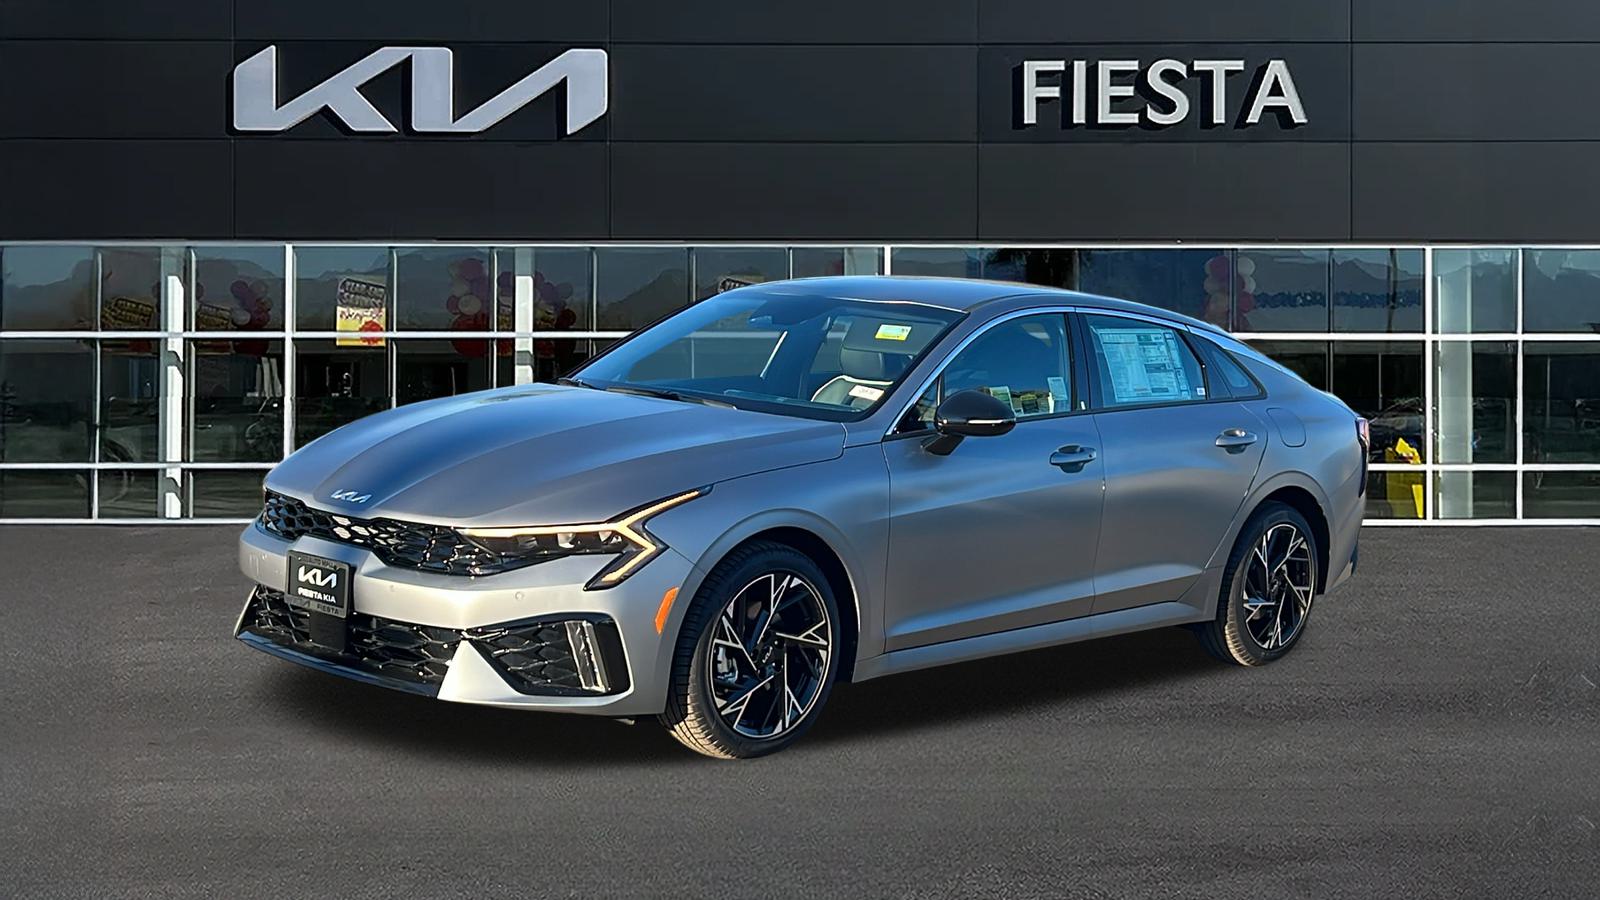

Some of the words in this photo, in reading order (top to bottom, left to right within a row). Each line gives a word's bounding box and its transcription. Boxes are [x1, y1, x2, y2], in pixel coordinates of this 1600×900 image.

[233, 44, 608, 135] KIA
[1023, 59, 1308, 125] FIESTA
[331, 488, 372, 504] KIA
[298, 565, 337, 588] KIA
[323, 593, 337, 604] KIA
